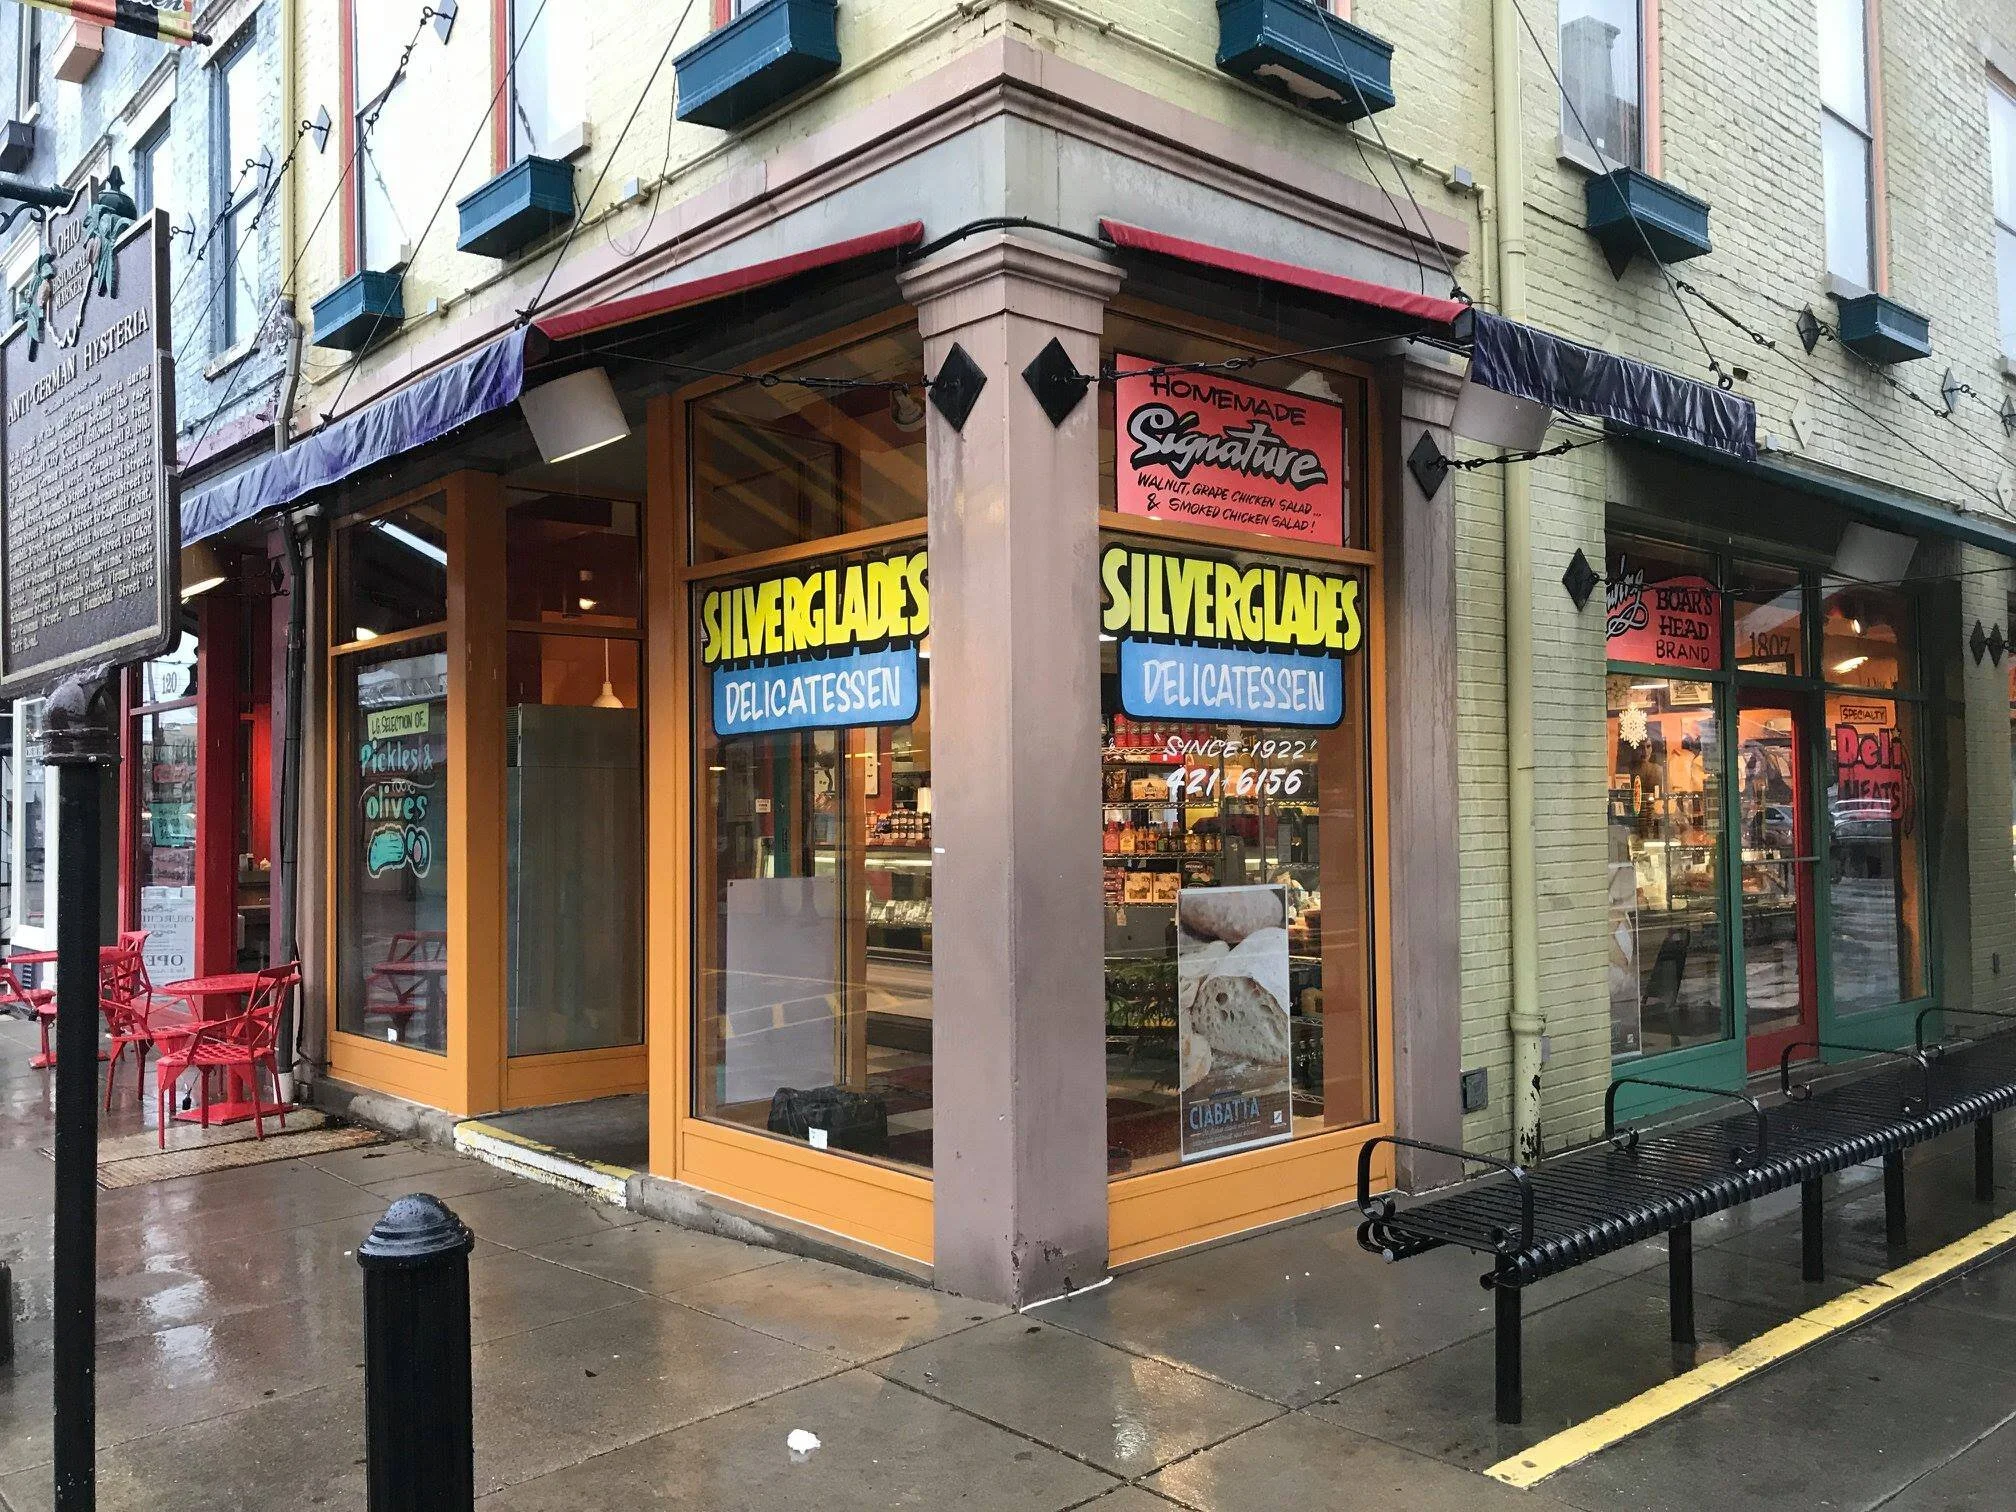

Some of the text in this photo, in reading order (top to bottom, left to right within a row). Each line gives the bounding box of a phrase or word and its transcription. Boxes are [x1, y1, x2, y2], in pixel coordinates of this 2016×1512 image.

[57, 218, 80, 257] OHIO
[55, 278, 83, 311] MARKER
[8, 354, 78, 427] ANTI-GERMAN
[84, 306, 150, 371] HYSTERIA
[95, 380, 123, 410] hysteria
[126, 362, 151, 387] during
[116, 393, 128, 411] the
[1150, 374, 1306, 425] HOMEMADE
[62, 435, 83, 460] Council
[86, 417, 112, 446] followed
[116, 411, 128, 428] the
[131, 394, 151, 419] trend
[89, 453, 113, 477] German
[117, 435, 139, 461] Street
[142, 429, 151, 446] to
[125, 446, 151, 474] Street,
[1127, 403, 1328, 490] Signature
[118, 470, 141, 494] Street
[143, 466, 151, 481] to
[1137, 471, 1190, 496] WALNUT,
[1192, 482, 1228, 501] GRAPE
[1231, 490, 1275, 509] CHICKEN
[120, 503, 152, 528] Hamburg
[1147, 492, 1160, 512] &
[1168, 497, 1221, 518] SMOKED
[1222, 508, 1269, 527] CHICKEN
[122, 529, 131, 545] to
[131, 521, 152, 541] Yukon
[82, 566, 89, 579] to
[130, 554, 153, 577] Street
[117, 577, 141, 599] Street
[145, 573, 153, 588] to
[1101, 547, 1362, 651] SILVERGLADES
[703, 551, 929, 664] SILVERGLADES
[1658, 614, 1710, 641] HEAD
[1656, 639, 1710, 664] BRAND
[162, 671, 177, 694] 120
[724, 665, 900, 725] DELICATESSEN
[1142, 659, 1325, 712] DELICATESSEN
[381, 712, 413, 734] SELECTION
[1842, 707, 1886, 721] SPECIALTY
[360, 739, 434, 777] Pickles &
[1835, 723, 1904, 770] Deli
[366, 784, 428, 821] olives
[1189, 1096, 1261, 1130] CIABATTA
